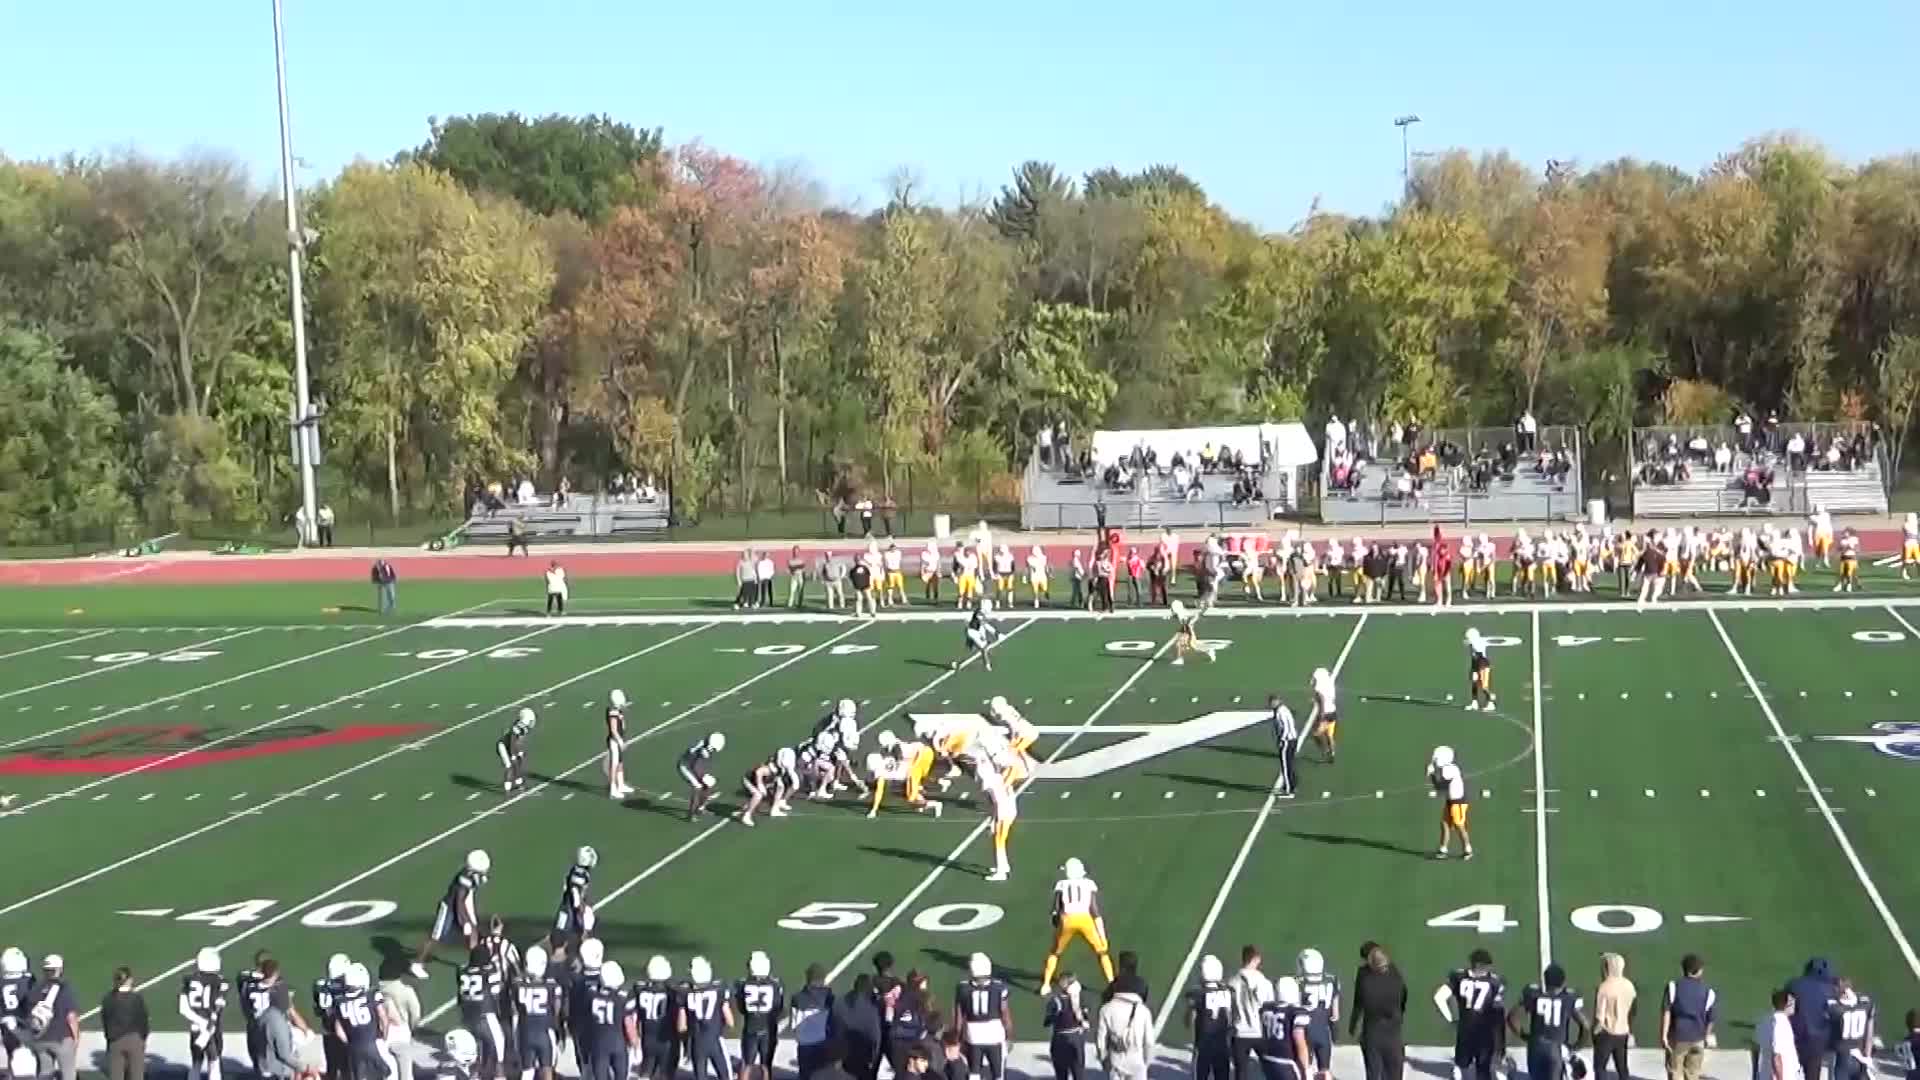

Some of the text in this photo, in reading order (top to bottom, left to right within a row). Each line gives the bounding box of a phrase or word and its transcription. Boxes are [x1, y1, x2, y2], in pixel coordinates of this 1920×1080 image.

[1067, 886, 1081, 903] 11
[188, 981, 211, 1008] 21
[460, 974, 484, 1000] 22
[518, 987, 549, 1014] 42
[744, 984, 774, 1012] 23
[1459, 979, 1490, 1010] 97
[339, 997, 371, 1026] 46
[592, 998, 614, 1025] 51
[639, 992, 667, 1020] 90
[687, 991, 718, 1020] 47
[971, 990, 988, 1014] 11
[1536, 998, 1562, 1027] 91
[1841, 1010, 1866, 1040] 10
